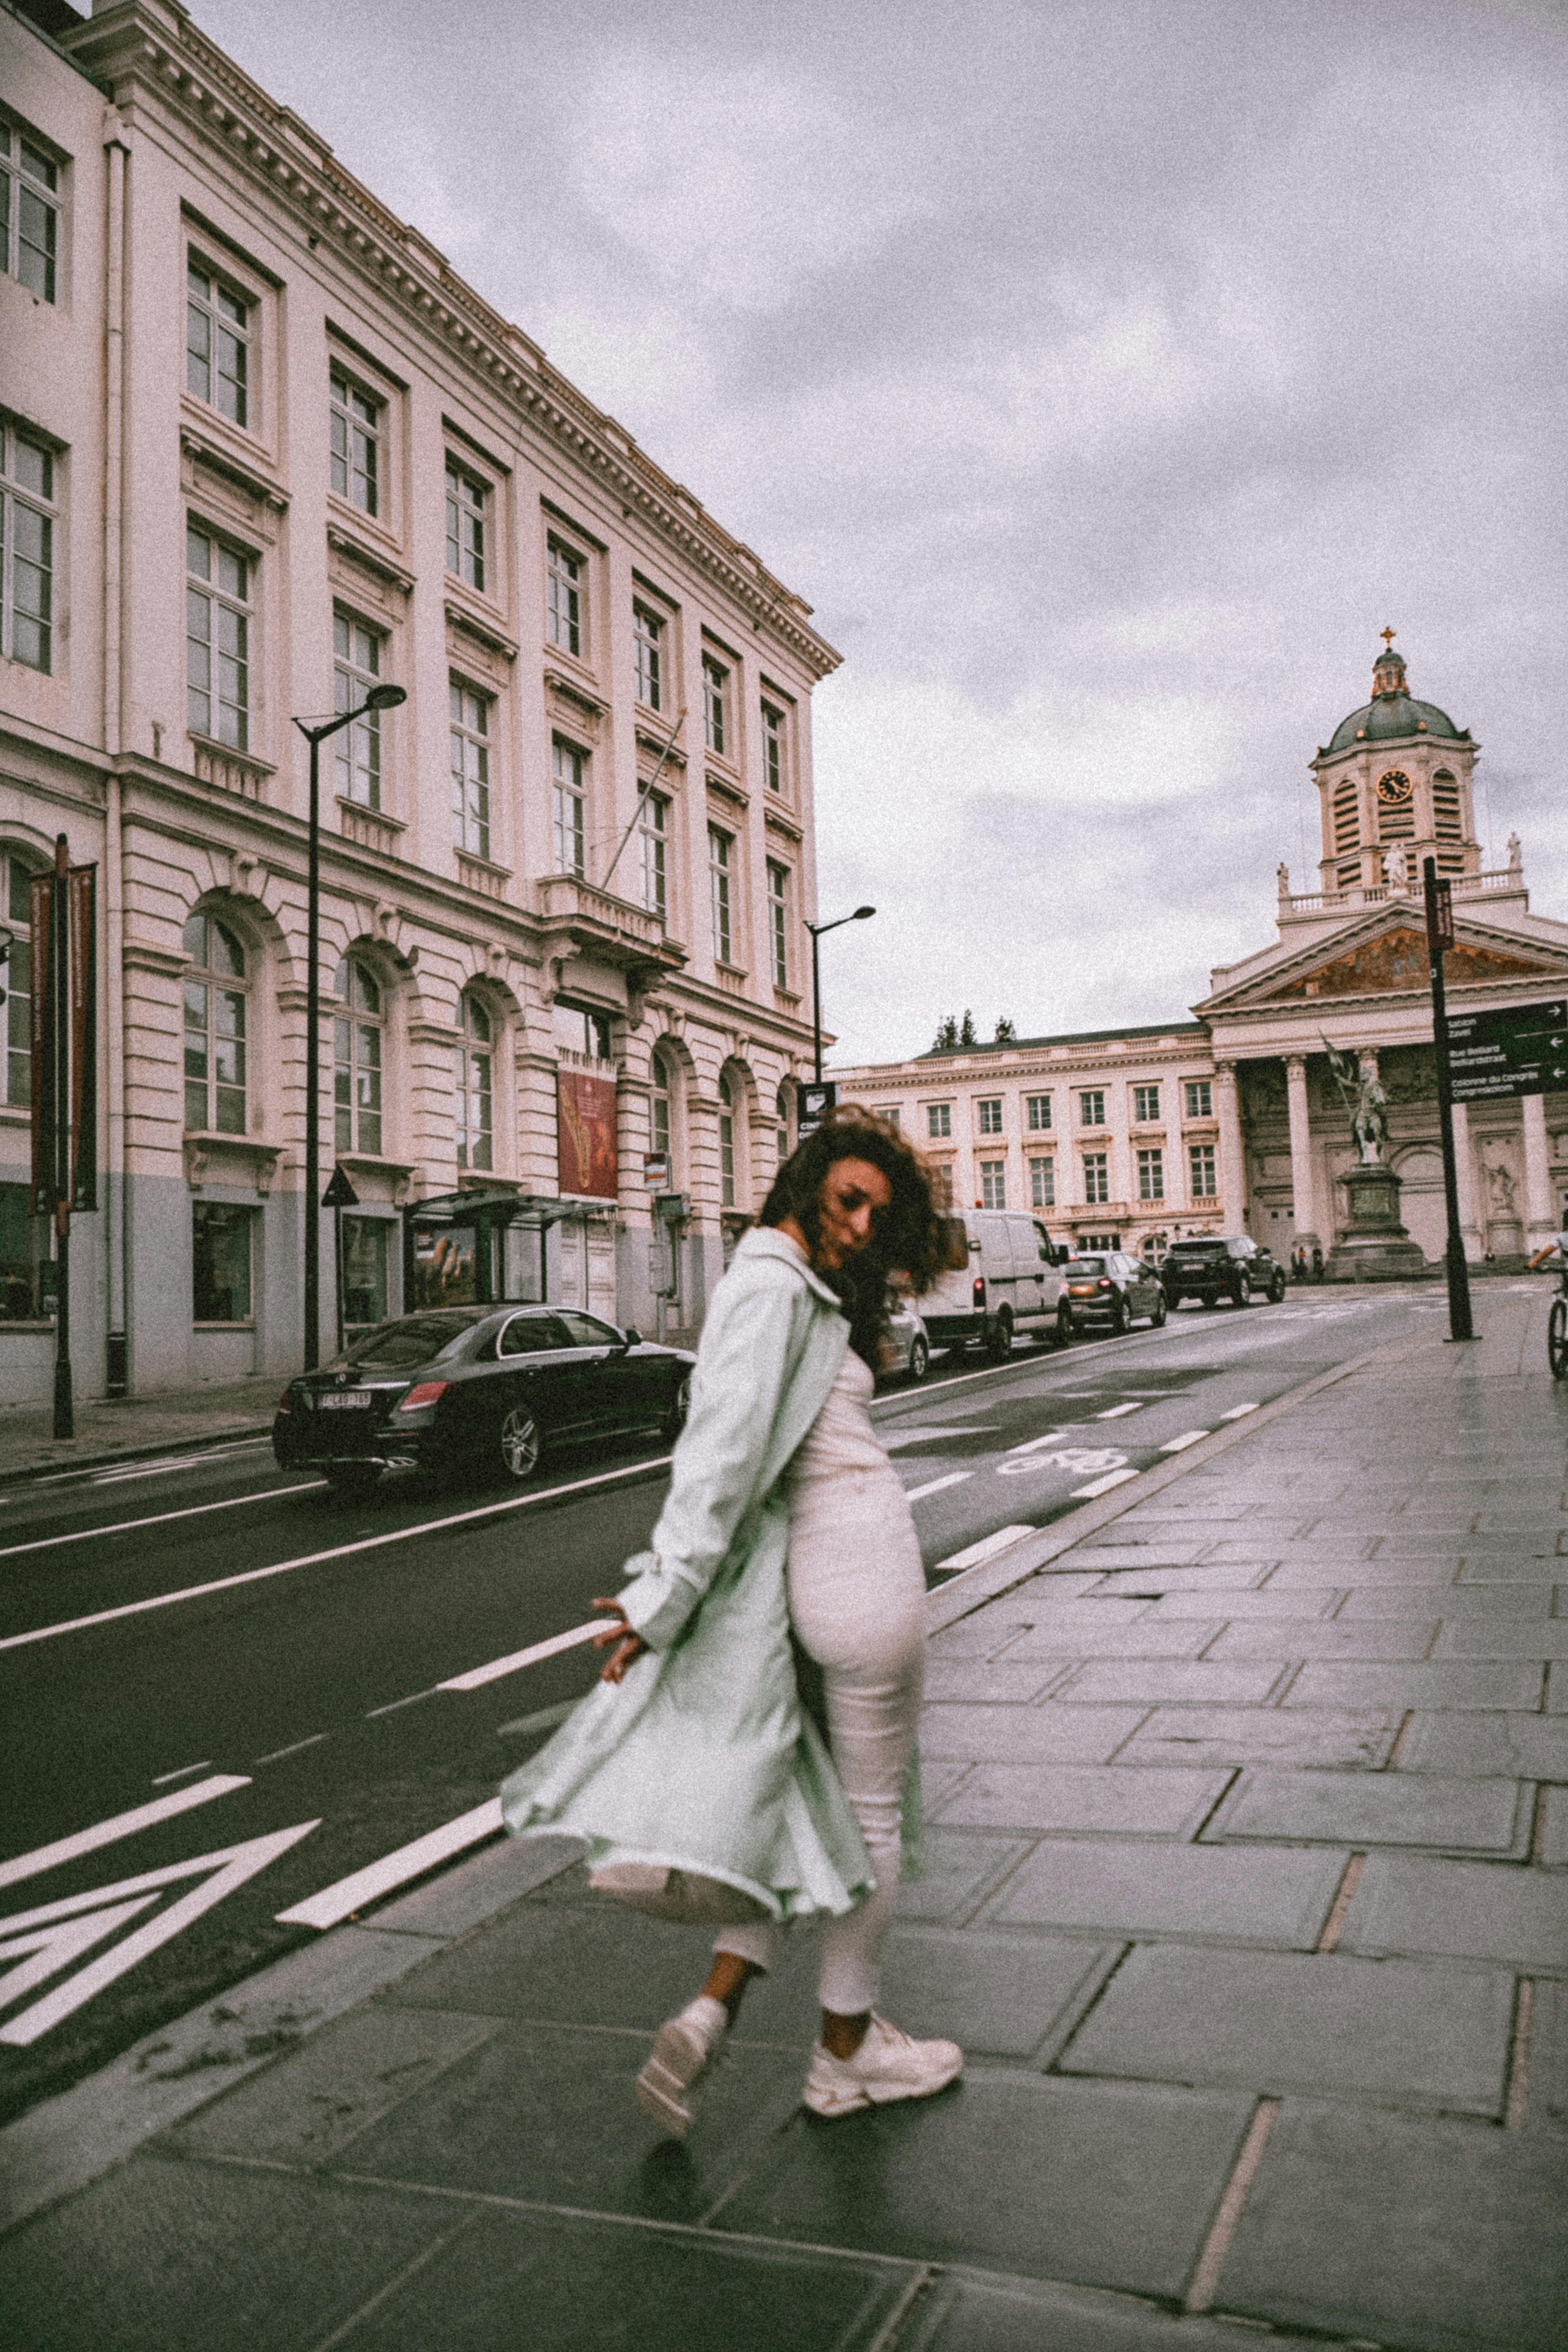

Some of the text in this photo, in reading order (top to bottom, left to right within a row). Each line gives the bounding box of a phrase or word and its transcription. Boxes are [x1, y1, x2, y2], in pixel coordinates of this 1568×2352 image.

[1448, 1019, 1476, 1028] Sablon
[1448, 1028, 1471, 1038] Zavel
[1467, 1045, 1500, 1056] Belliard
[1452, 1078, 1486, 1087] Colonne
